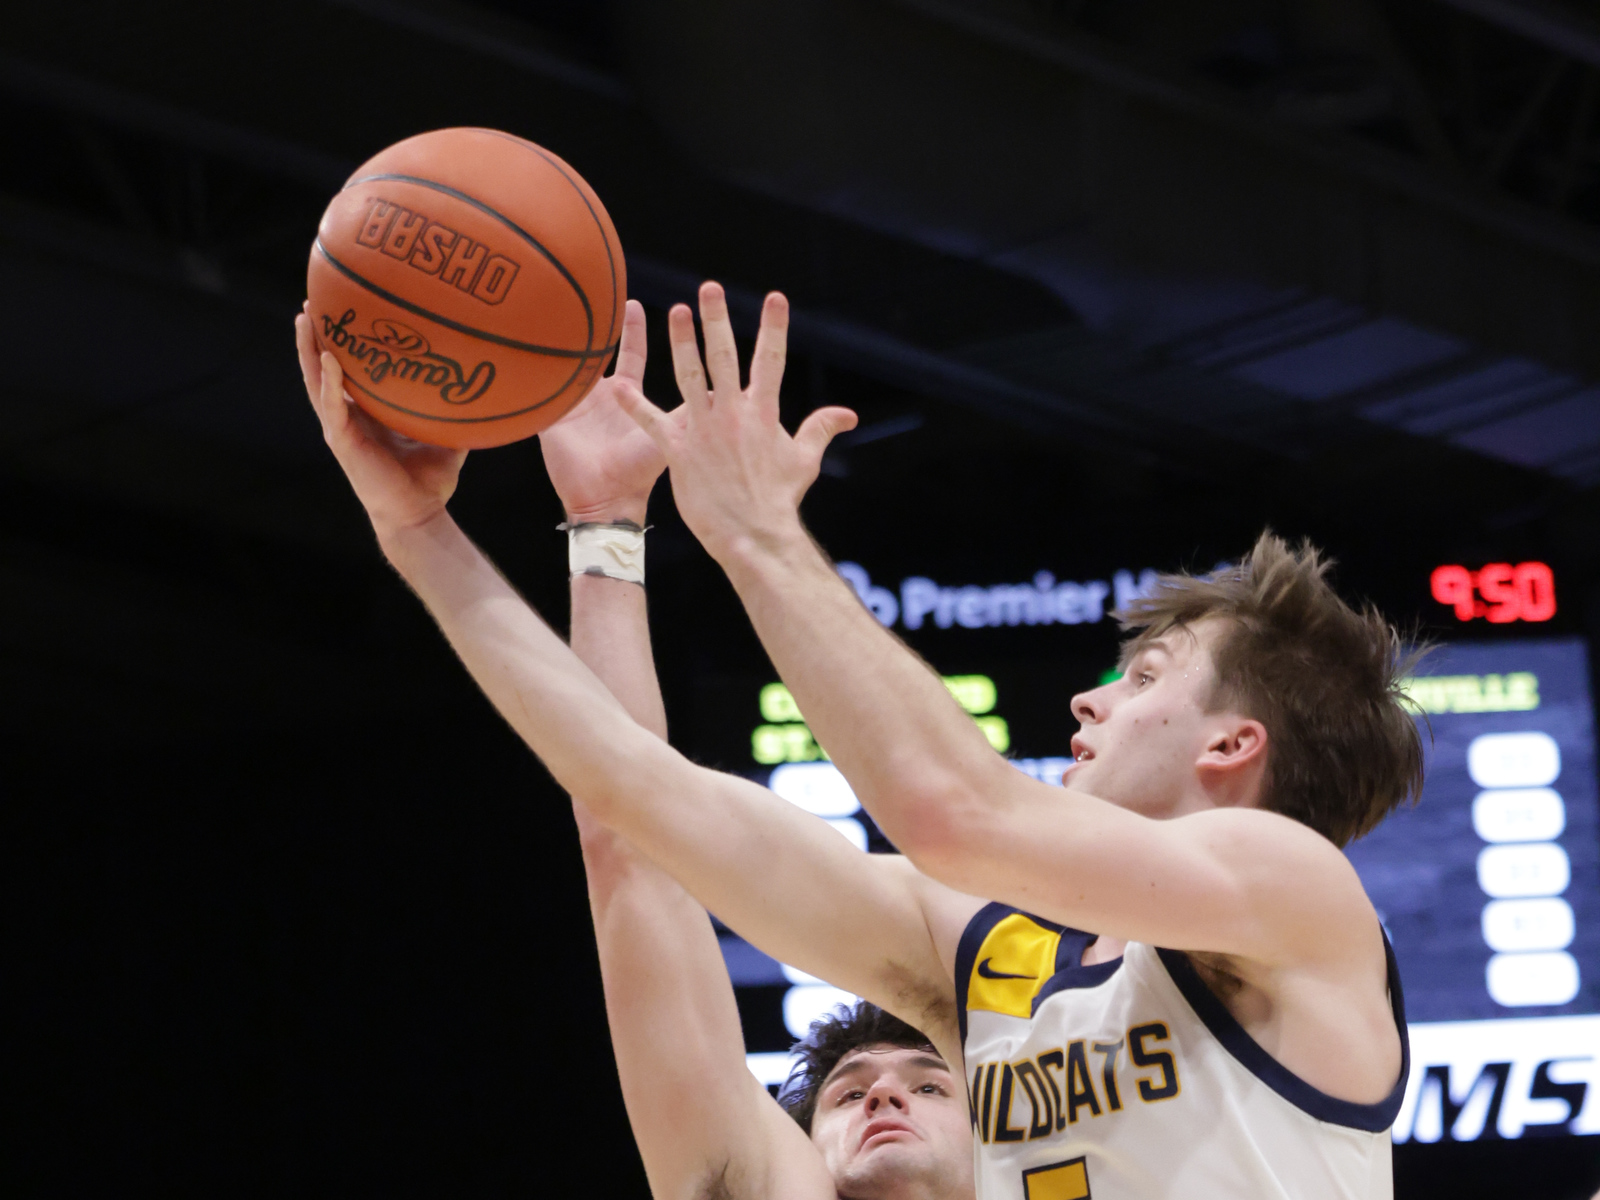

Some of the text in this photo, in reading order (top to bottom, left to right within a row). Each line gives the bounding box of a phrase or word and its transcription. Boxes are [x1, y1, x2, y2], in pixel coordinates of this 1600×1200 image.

[355, 197, 521, 306] OHSAA
[321, 308, 496, 405] Rawlings
[901, 569, 1110, 631] Premier
